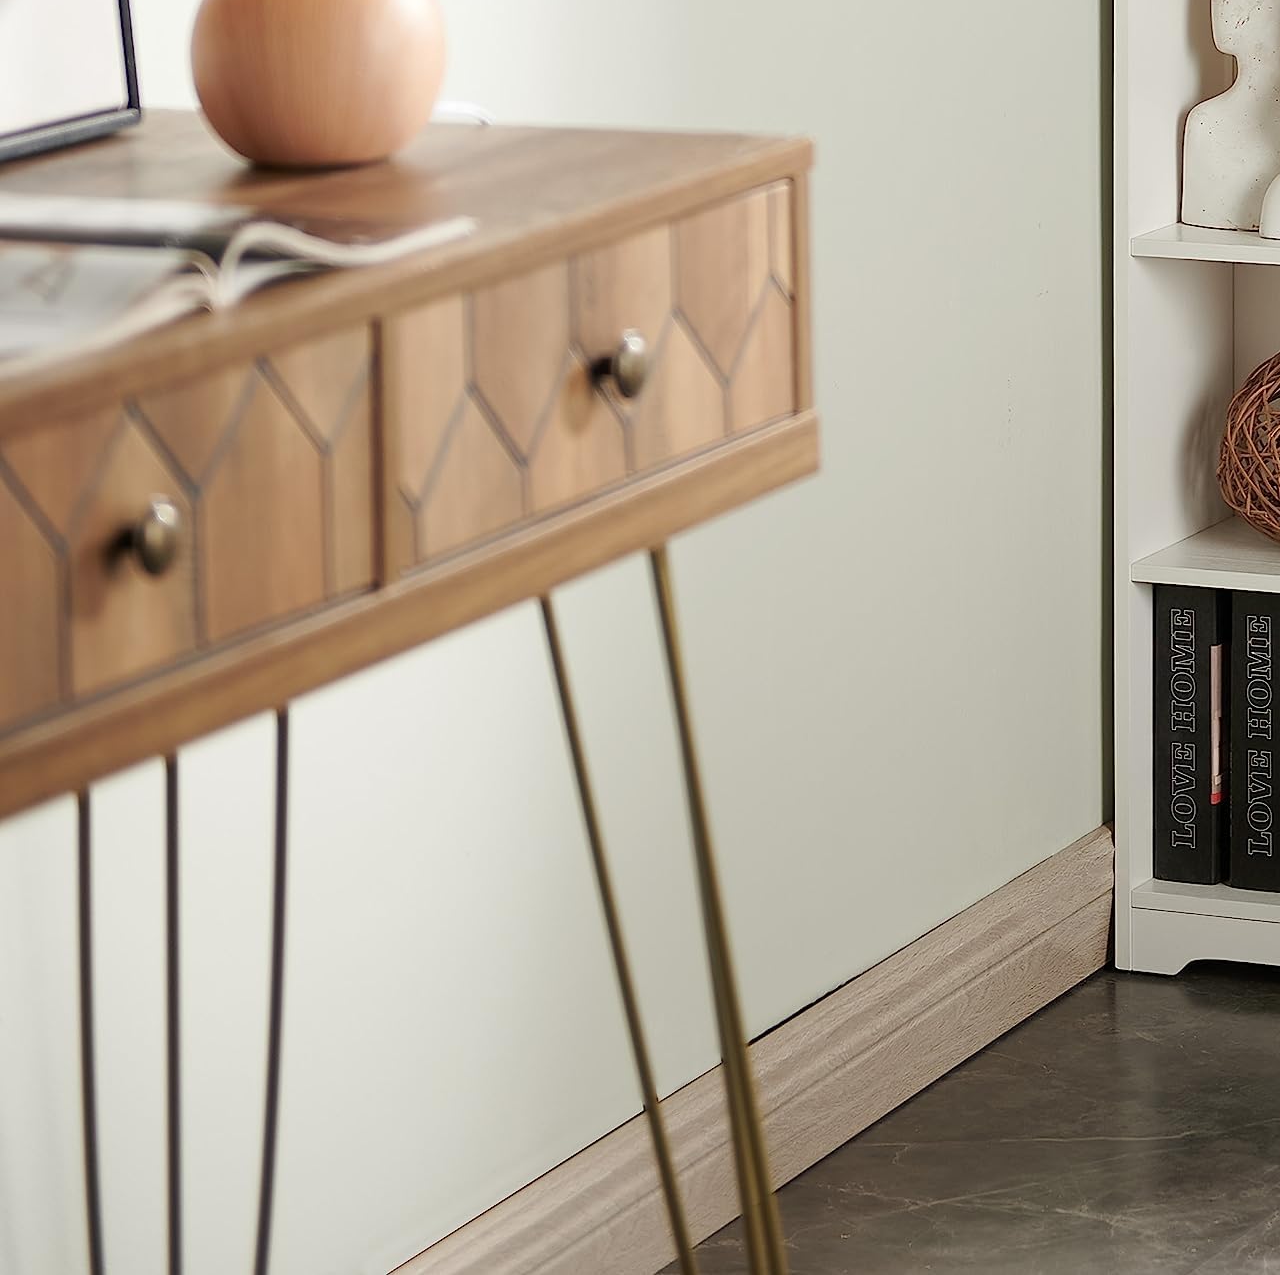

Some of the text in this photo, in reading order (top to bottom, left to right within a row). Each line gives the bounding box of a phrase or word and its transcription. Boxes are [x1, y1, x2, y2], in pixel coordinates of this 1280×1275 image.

[1171, 608, 1197, 849] LOVE HOME
[1246, 615, 1273, 857] LOVE HOME
